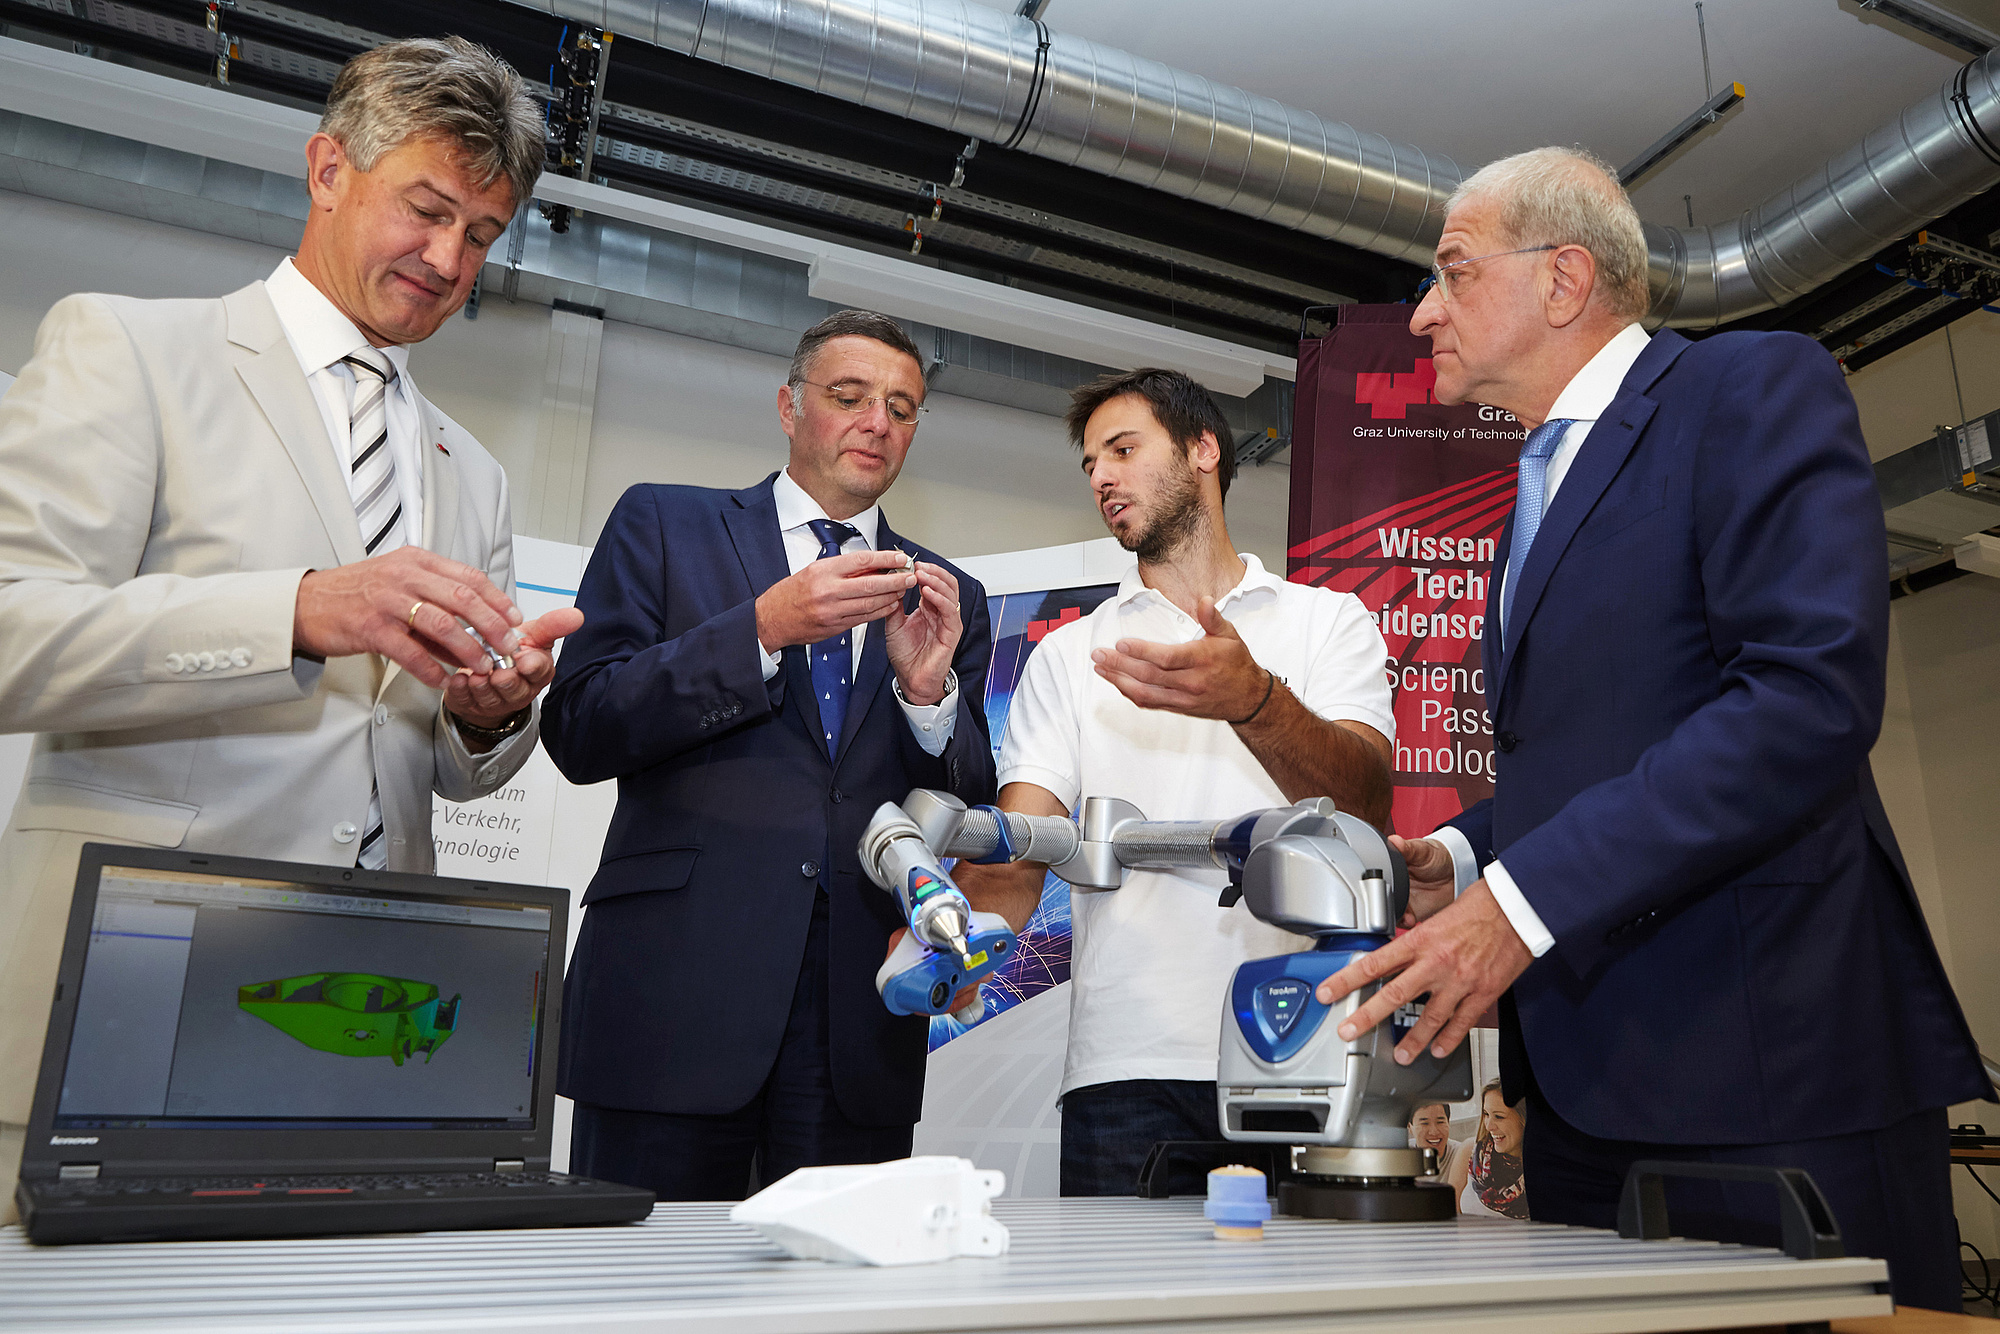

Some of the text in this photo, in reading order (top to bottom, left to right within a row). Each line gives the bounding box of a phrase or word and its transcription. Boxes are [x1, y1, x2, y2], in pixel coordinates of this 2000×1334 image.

[1478, 406, 1519, 421] Gra
[1353, 426, 1383, 438] Graz
[1387, 426, 1450, 441] University
[1453, 427, 1466, 439] of
[1378, 527, 1495, 562] Wissen
[1411, 567, 1490, 601] Tech
[1421, 699, 1495, 735] Pass
[488, 788, 526, 802] um
[445, 805, 521, 834] Verkehr,
